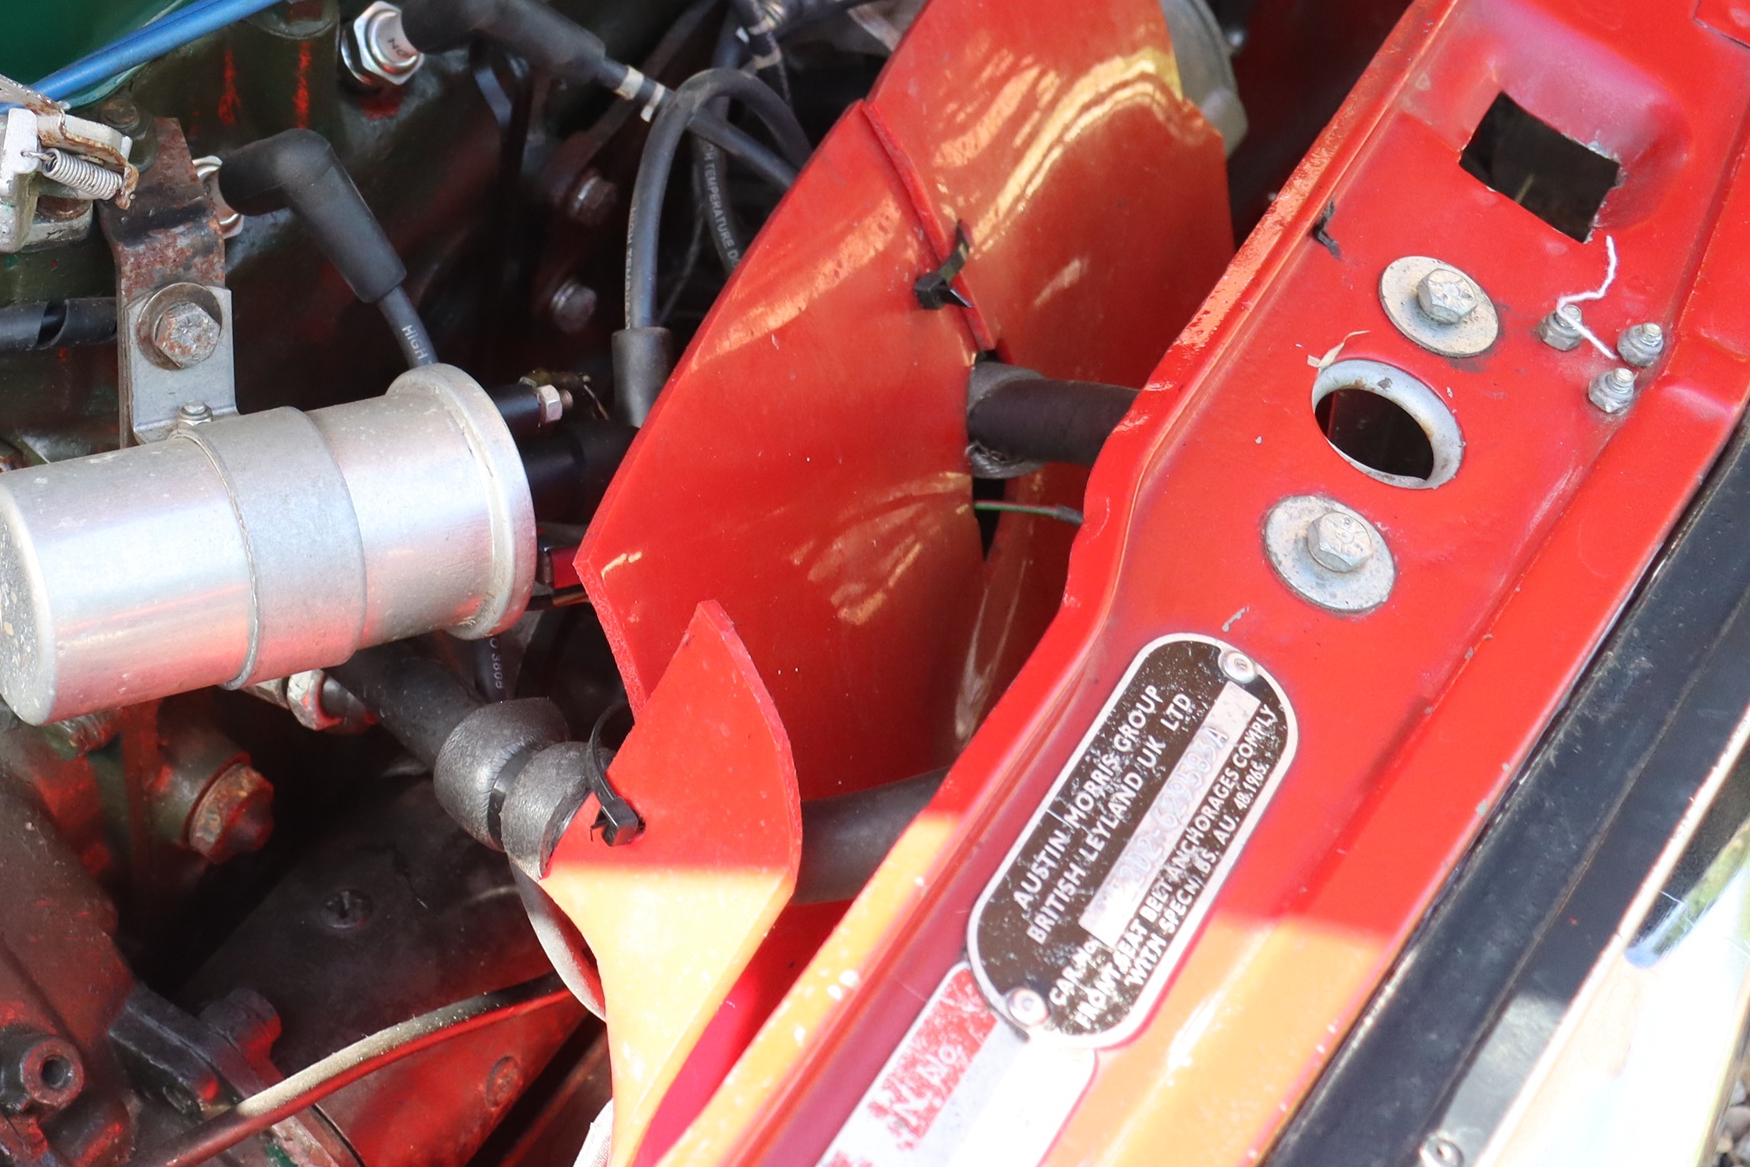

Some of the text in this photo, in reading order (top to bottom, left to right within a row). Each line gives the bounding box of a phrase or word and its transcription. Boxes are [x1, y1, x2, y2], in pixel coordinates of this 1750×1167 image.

[703, 165, 735, 250] TEMPERATURE
[401, 324, 429, 360] HIGH
[1010, 683, 1166, 911] AUSTIN MORRIS GROUP
[1025, 690, 1193, 945] BRITISH LEYLAND UK LTD
[1072, 703, 1278, 1029] FRONT SEAT BELT ANCHORAGES COMPLY
[1124, 931, 1168, 988] WITH
